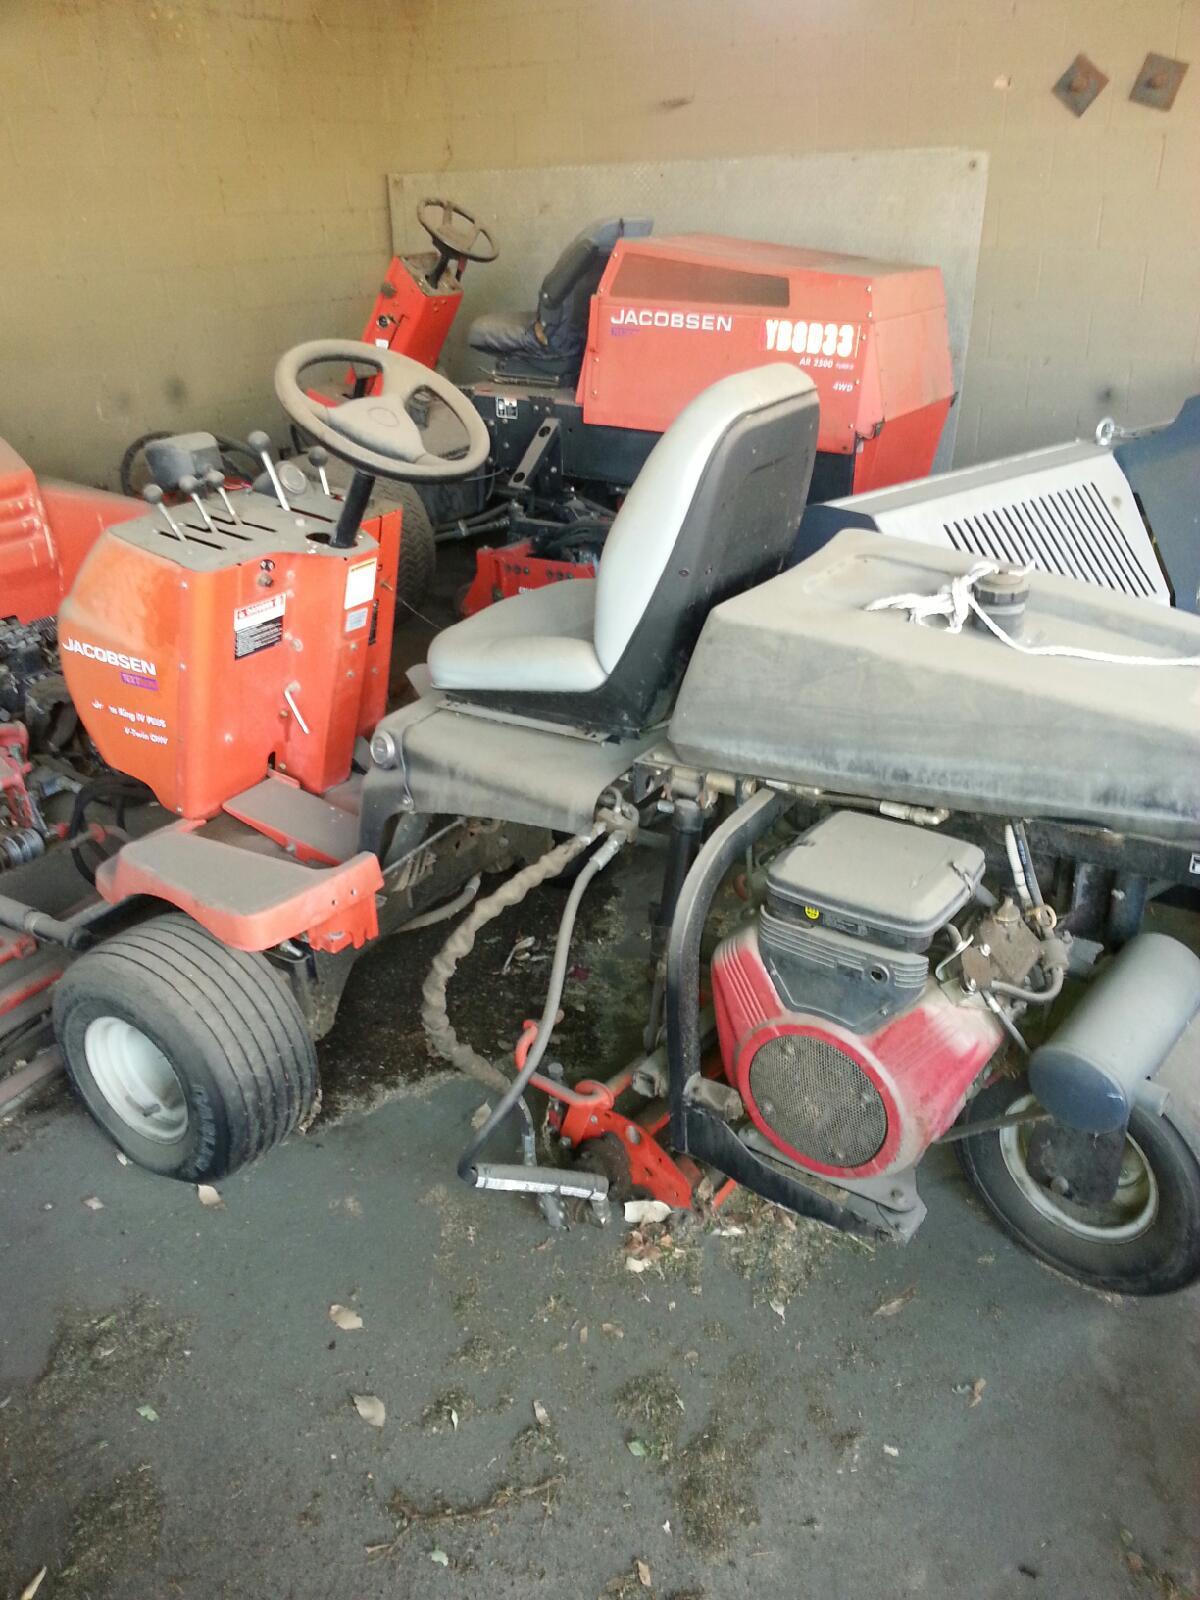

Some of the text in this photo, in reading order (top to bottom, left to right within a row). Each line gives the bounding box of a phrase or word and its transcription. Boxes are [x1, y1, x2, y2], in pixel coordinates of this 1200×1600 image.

[610, 308, 733, 331] JACOBSEN
[832, 382, 853, 392] 4WD
[62, 637, 157, 676] JACOBSEN
